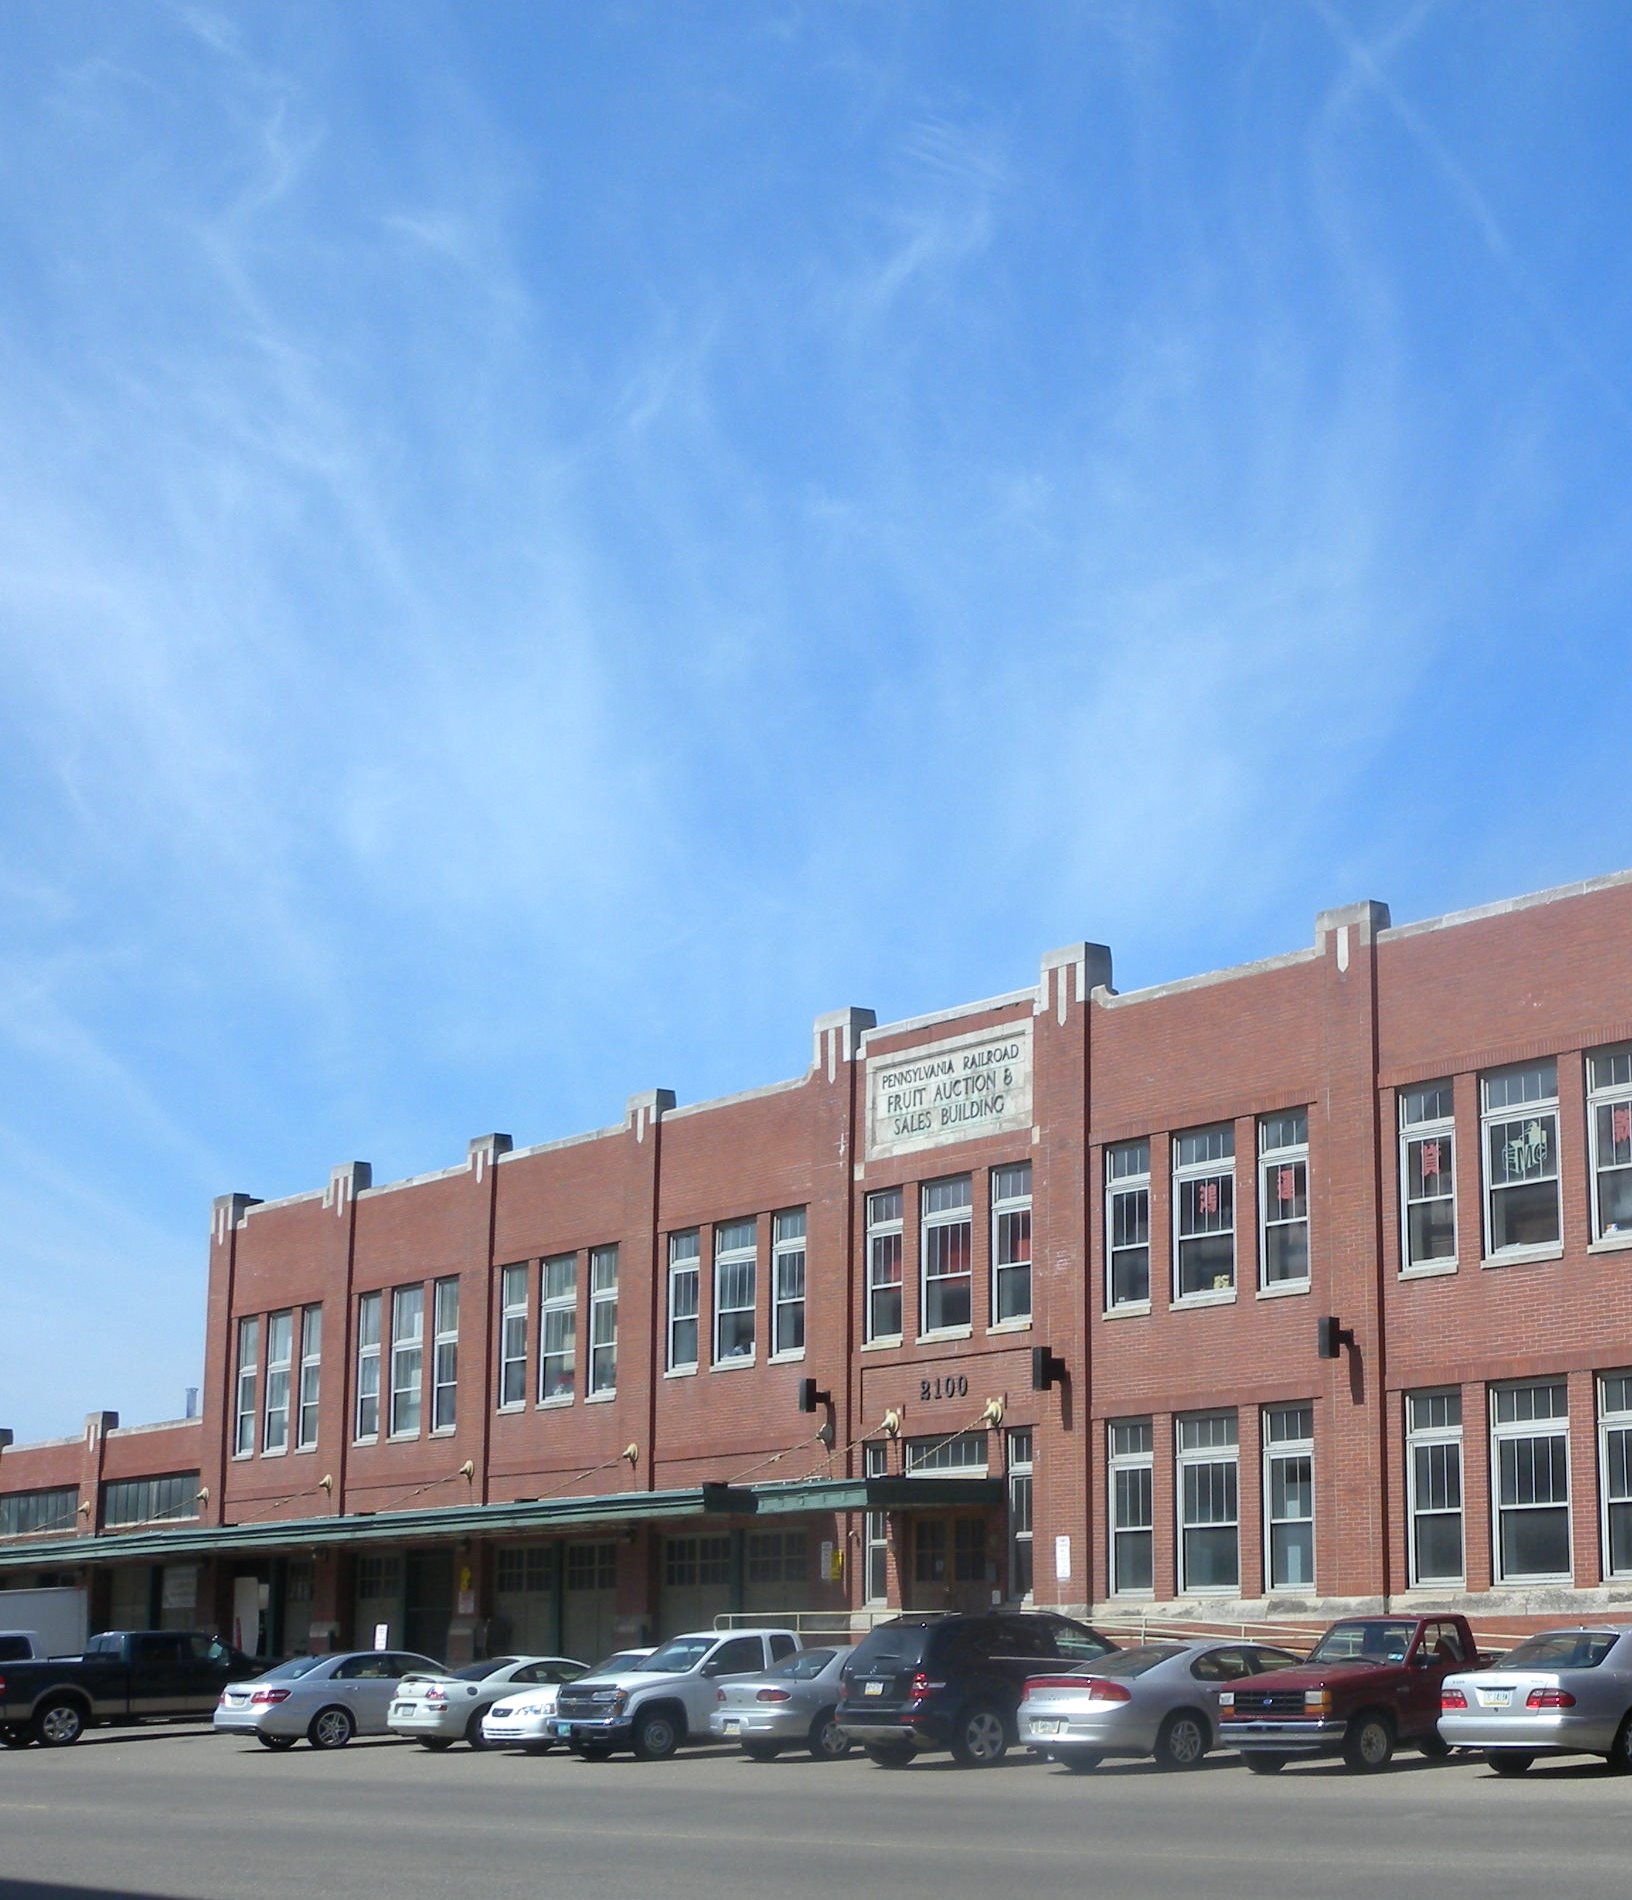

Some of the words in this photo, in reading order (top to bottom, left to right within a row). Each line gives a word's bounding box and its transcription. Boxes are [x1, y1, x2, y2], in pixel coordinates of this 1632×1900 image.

[882, 1059, 955, 1090] PENNSYLVANIA
[963, 1044, 1019, 1071] RAILROAD
[887, 1088, 926, 1113] FRUIT
[934, 1071, 997, 1103] AUCTION
[894, 1111, 932, 1135] SALES
[941, 1095, 1005, 1125] BUILDING
[920, 1375, 968, 1401] 2100
